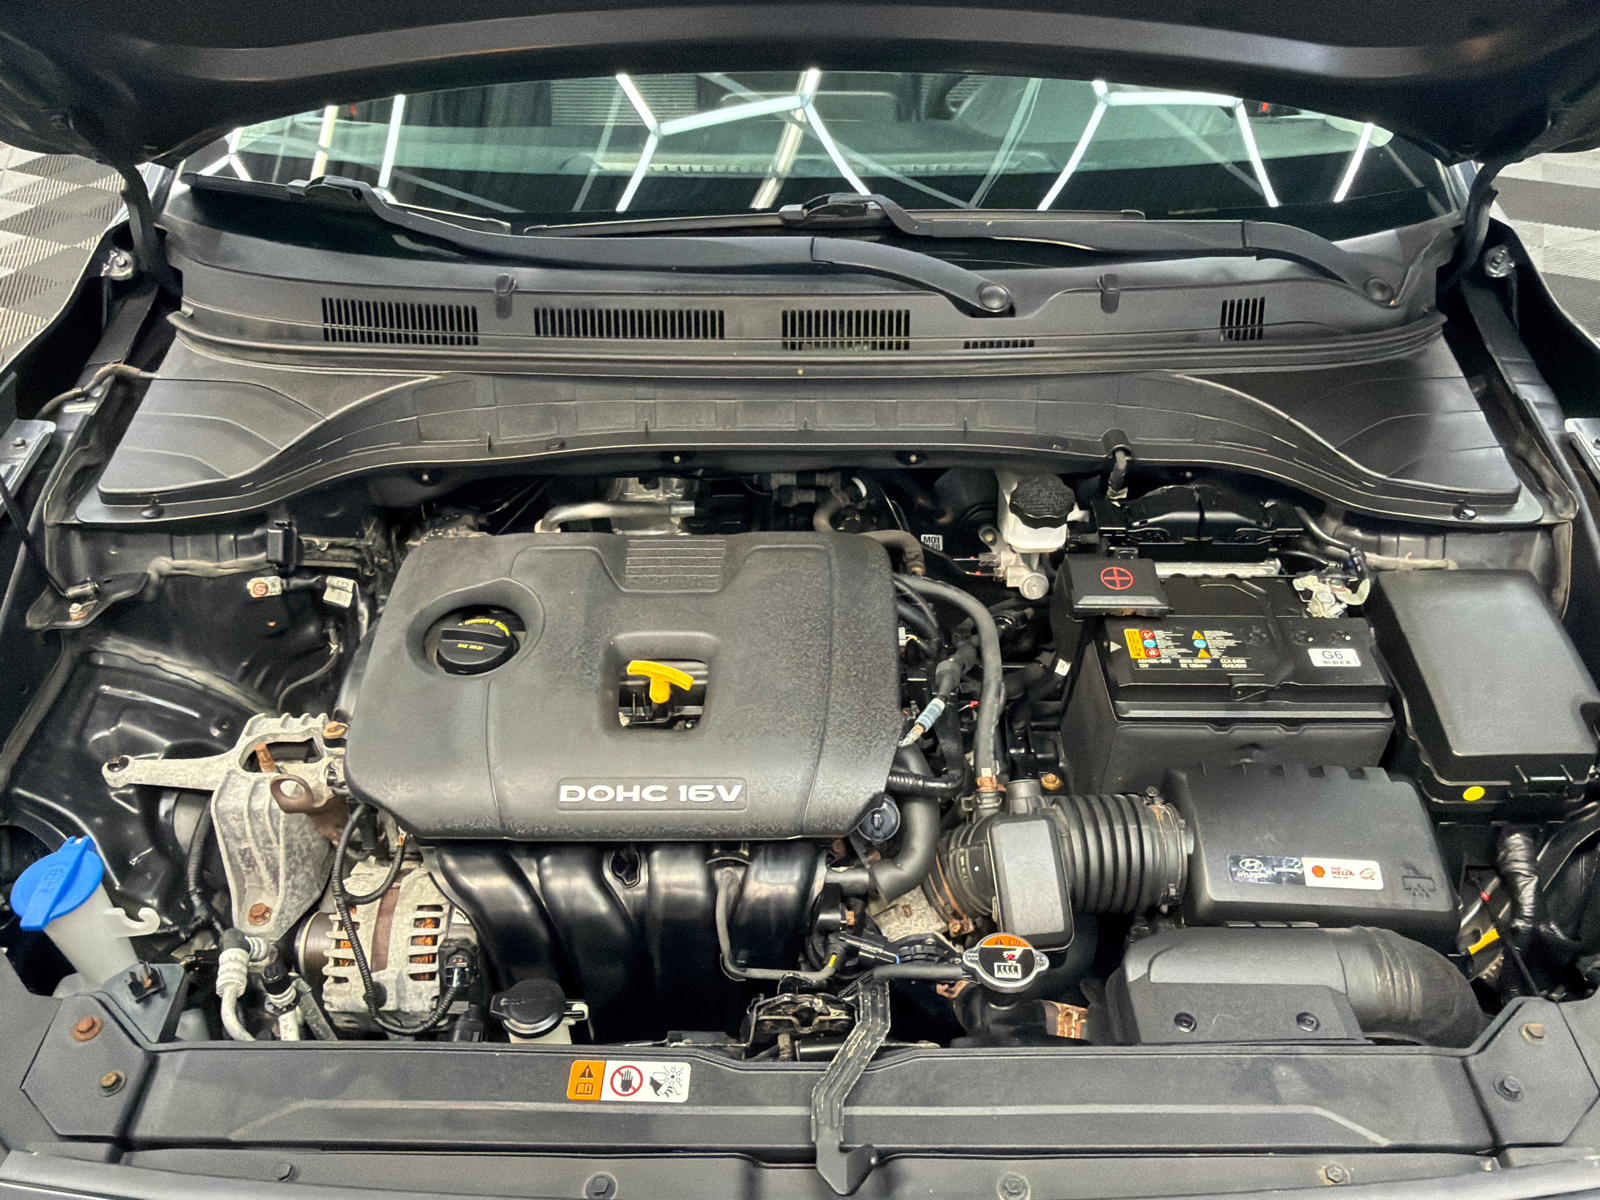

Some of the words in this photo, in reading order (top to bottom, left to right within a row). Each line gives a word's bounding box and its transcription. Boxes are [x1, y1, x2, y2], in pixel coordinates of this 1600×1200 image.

[1321, 650, 1344, 660] G6
[558, 784, 669, 803] DOHC
[678, 784, 743, 802] 16V
[1331, 869, 1355, 877] HELIX
